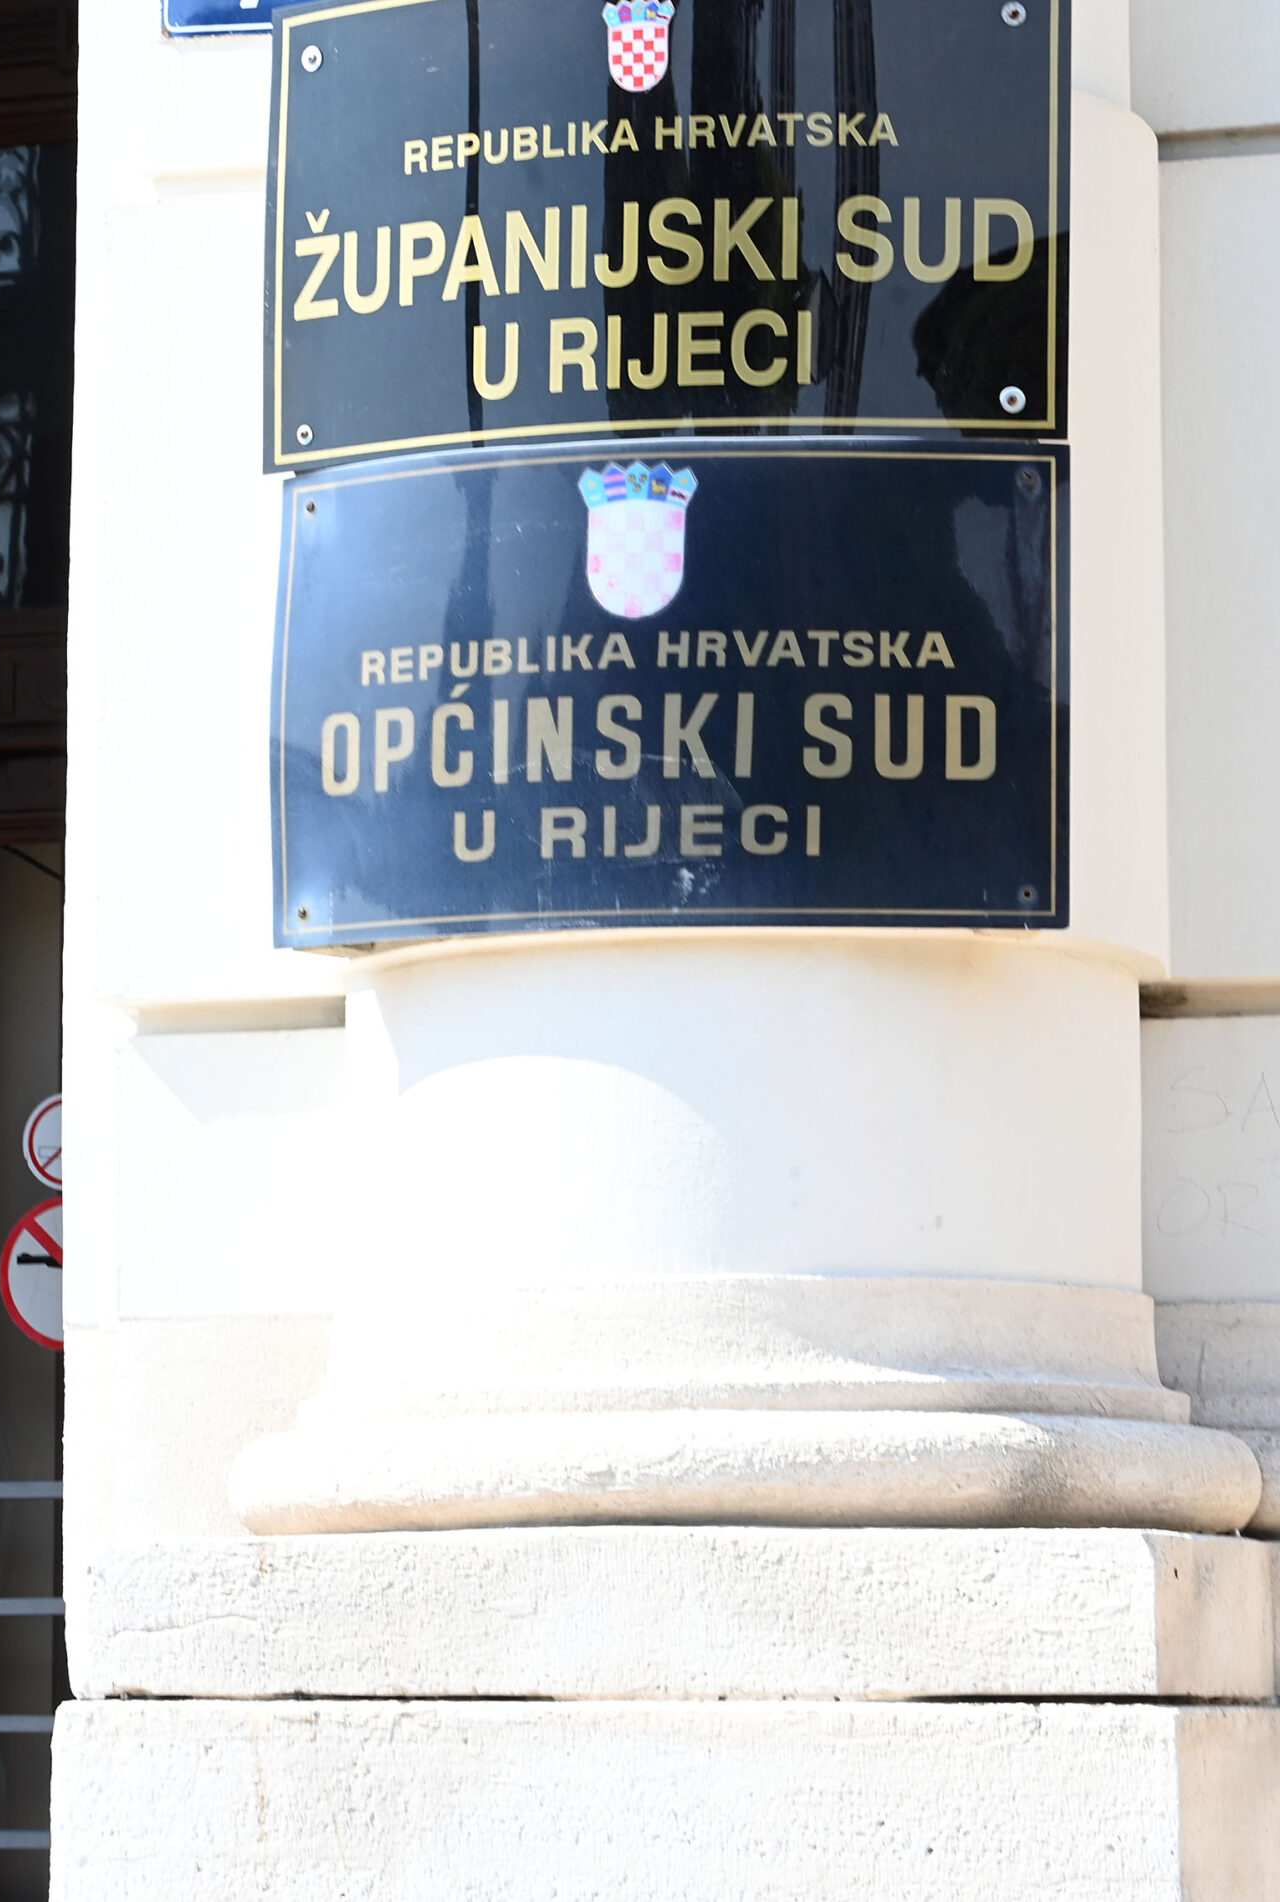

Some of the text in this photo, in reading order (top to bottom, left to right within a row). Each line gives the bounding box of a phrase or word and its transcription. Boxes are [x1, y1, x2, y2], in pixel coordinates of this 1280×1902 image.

[404, 112, 898, 175] REPUBLIKA HRVATSKA
[294, 195, 1034, 321] ŽUPANIJSKI SUD
[473, 310, 811, 400] U RIJECI
[361, 631, 954, 687] REPUBLIKA HRVATSKA
[321, 680, 996, 796] OPĆINSKI SUD
[454, 805, 820, 861] U RIJECI
